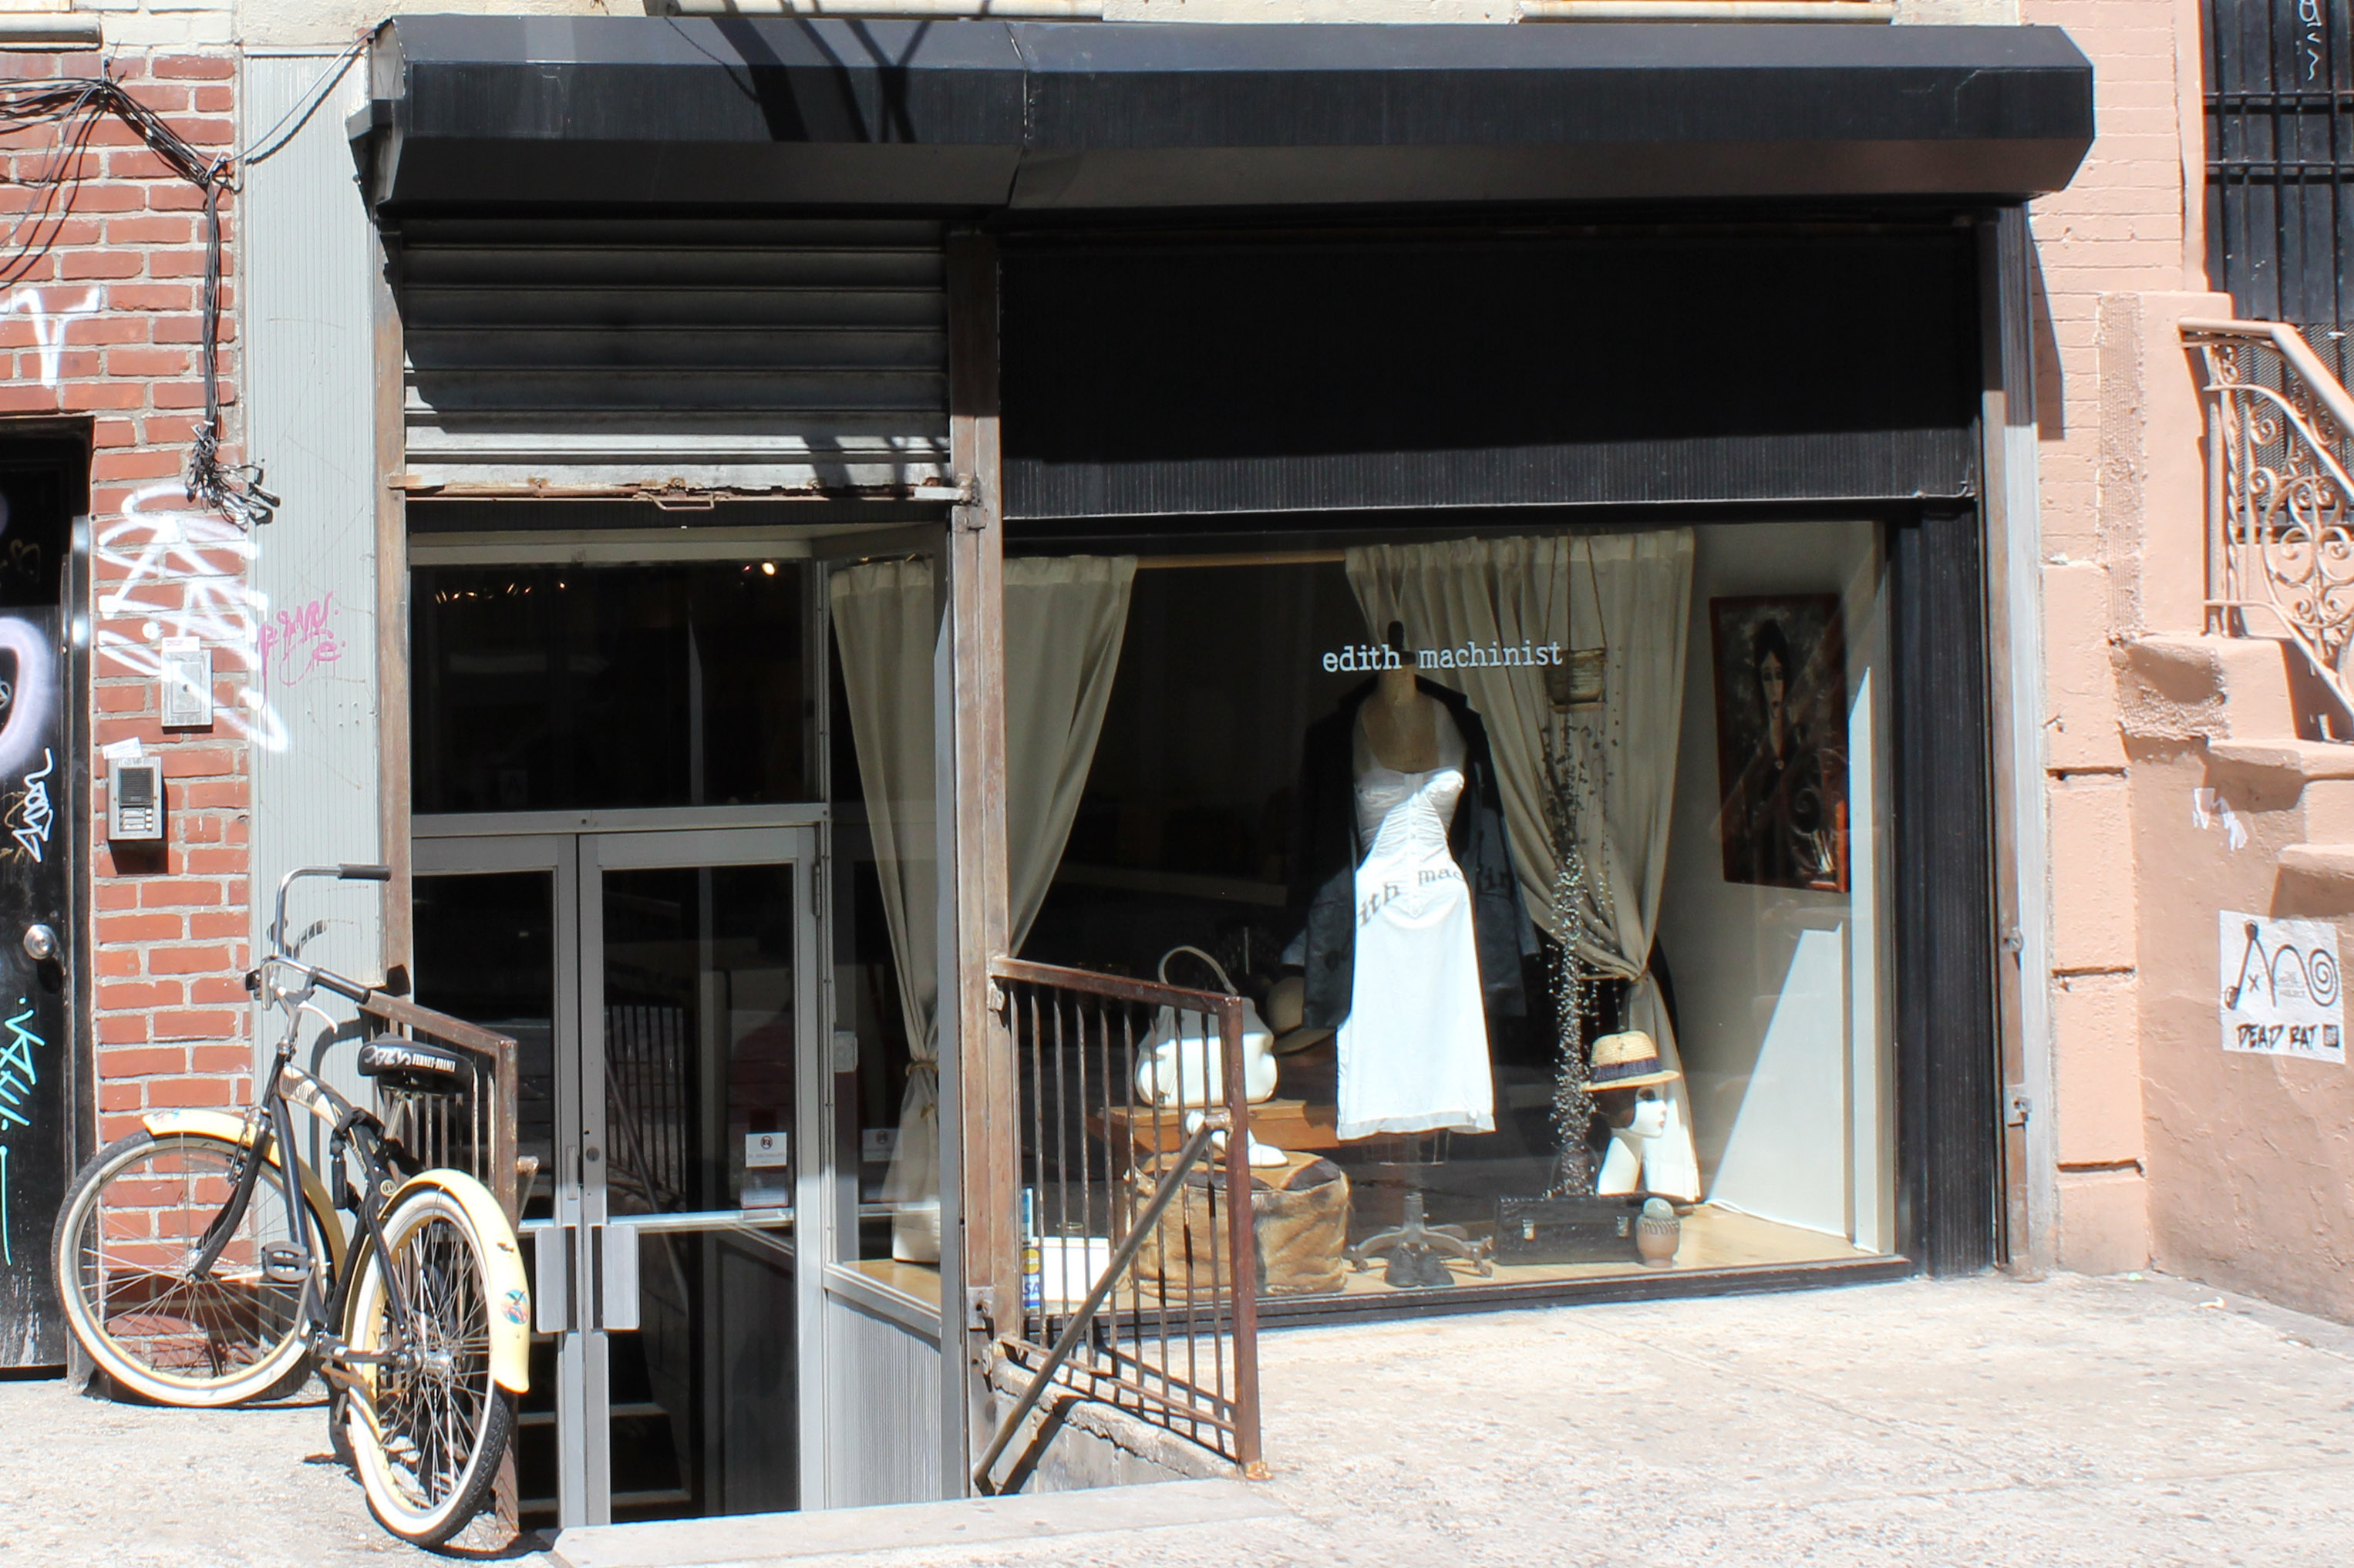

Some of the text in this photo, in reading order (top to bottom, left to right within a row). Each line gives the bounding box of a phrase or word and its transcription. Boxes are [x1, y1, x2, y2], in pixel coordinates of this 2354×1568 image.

[1322, 639, 1563, 673] edith machinist
[2237, 1024, 2319, 1050] DEAD RAT
[1022, 1282, 1041, 1297] SA
